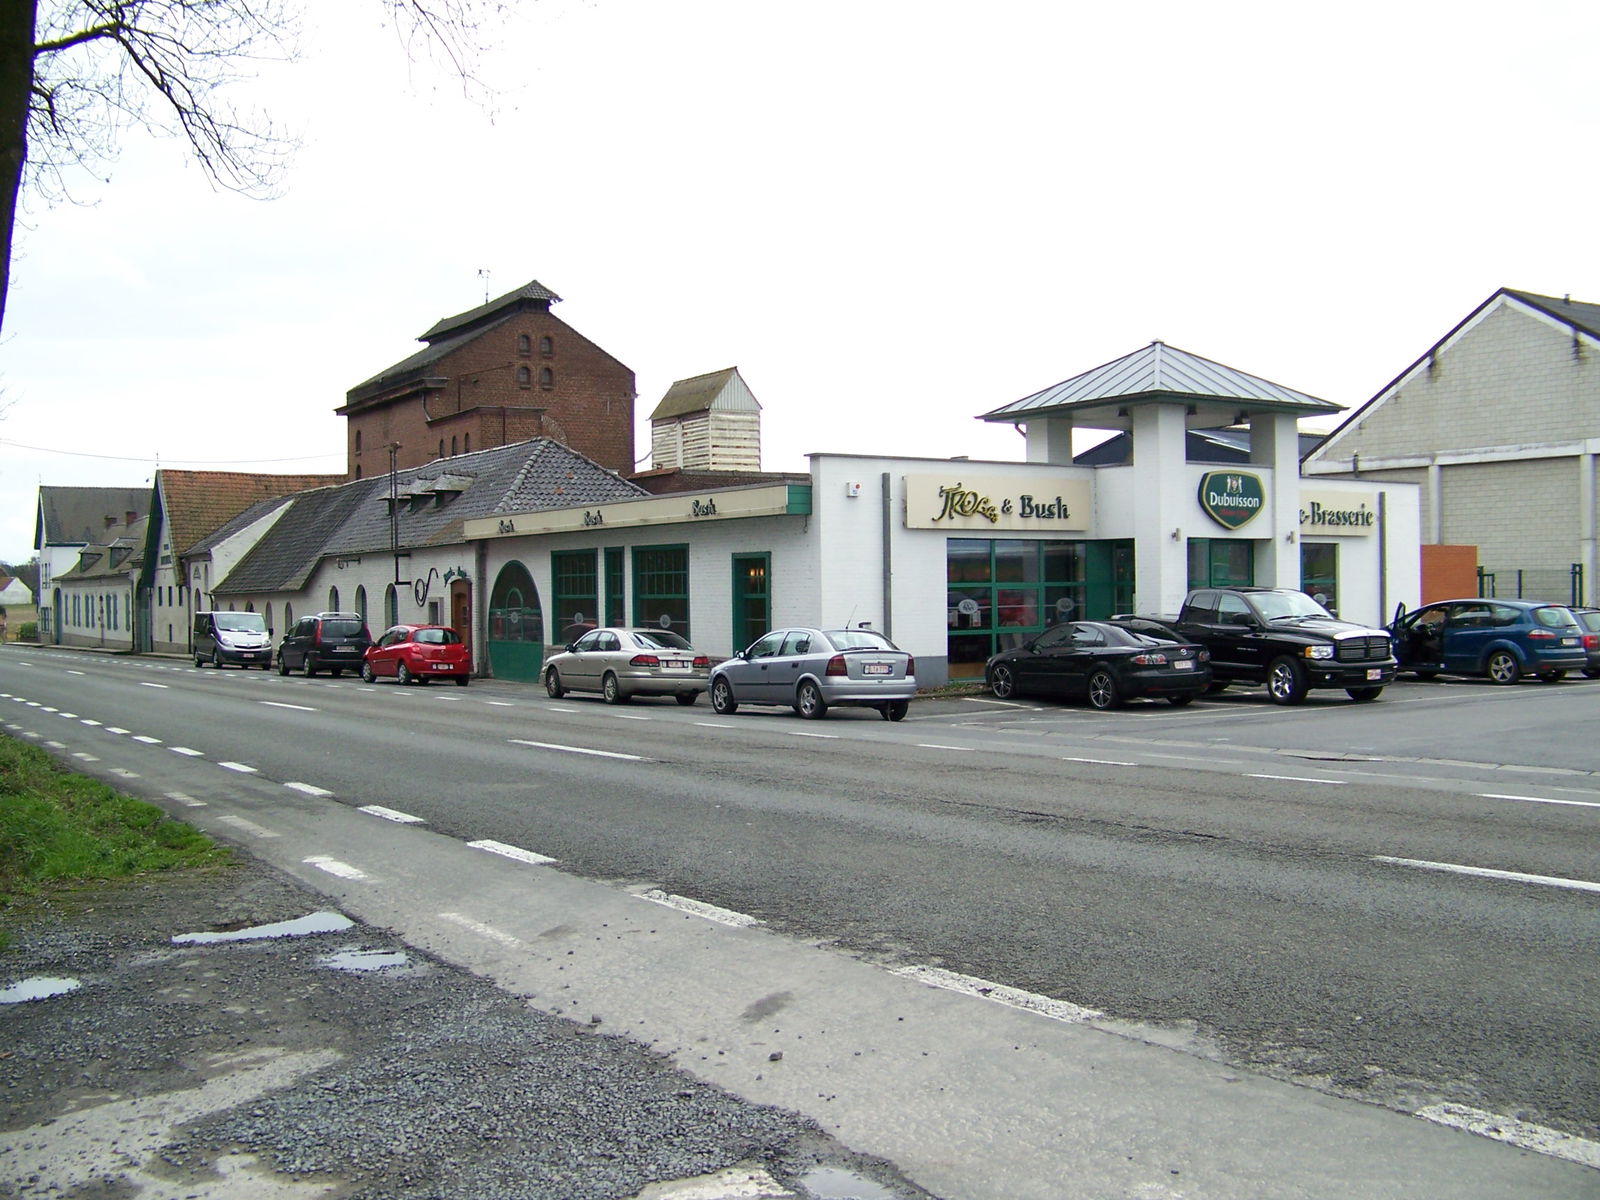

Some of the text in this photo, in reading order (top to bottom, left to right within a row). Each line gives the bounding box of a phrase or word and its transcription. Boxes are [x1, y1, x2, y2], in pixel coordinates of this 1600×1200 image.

[691, 498, 717, 517] Bush
[1001, 498, 1013, 515] &
[1019, 494, 1071, 519] Bush
[1210, 491, 1260, 508] Dubuisson
